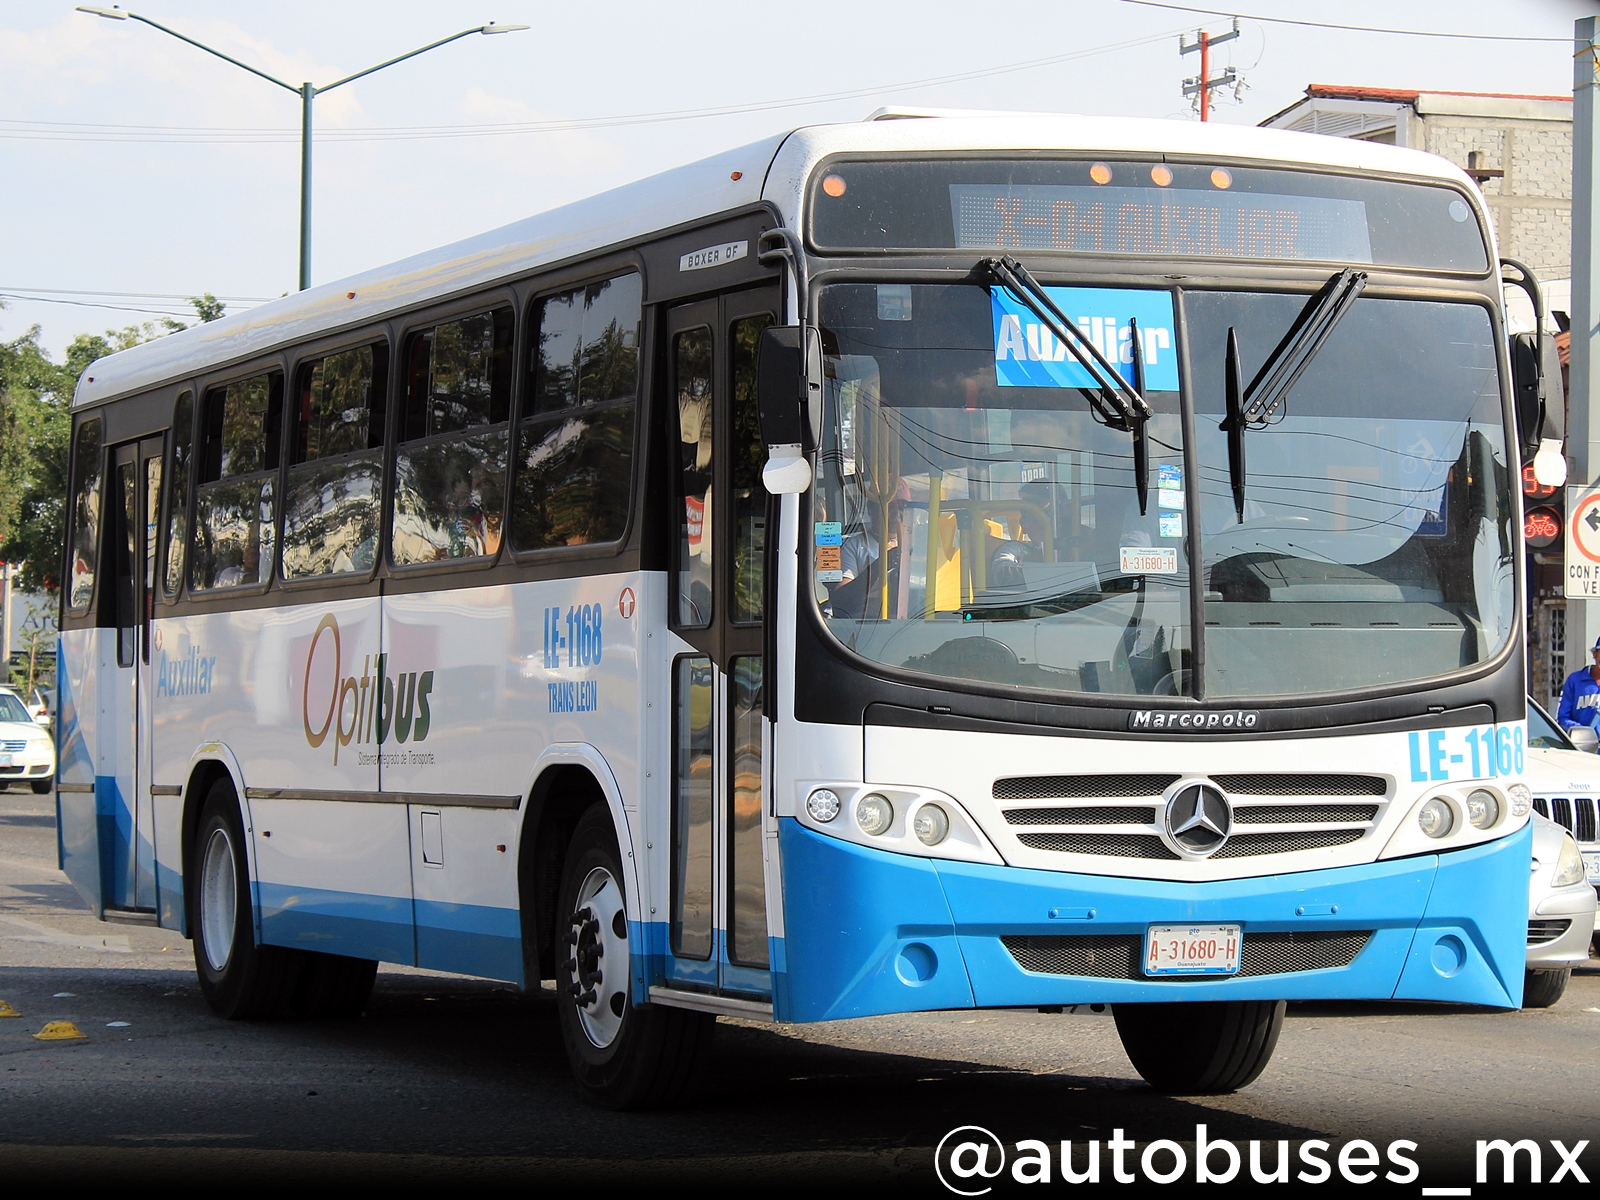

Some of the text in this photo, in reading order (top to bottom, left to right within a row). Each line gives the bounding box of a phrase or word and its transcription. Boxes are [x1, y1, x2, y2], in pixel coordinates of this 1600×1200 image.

[995, 197, 1299, 258] X-04 AUXILIAR
[688, 244, 739, 268] BOXER OF
[996, 313, 1170, 365] Auxiliar
[1122, 556, 1175, 570] A-31680-H
[1569, 564, 1590, 579] CON
[543, 602, 603, 669] LE-1168
[156, 644, 217, 698] Auxiliar
[302, 612, 435, 767] Optibus
[547, 680, 597, 713] TRANS LEON
[1132, 710, 1257, 730] Marcopolo
[358, 751, 377, 766] Sistema
[400, 750, 407, 765] de
[1407, 725, 1525, 783] LE-1168
[1149, 938, 1237, 961] A-31680-H
